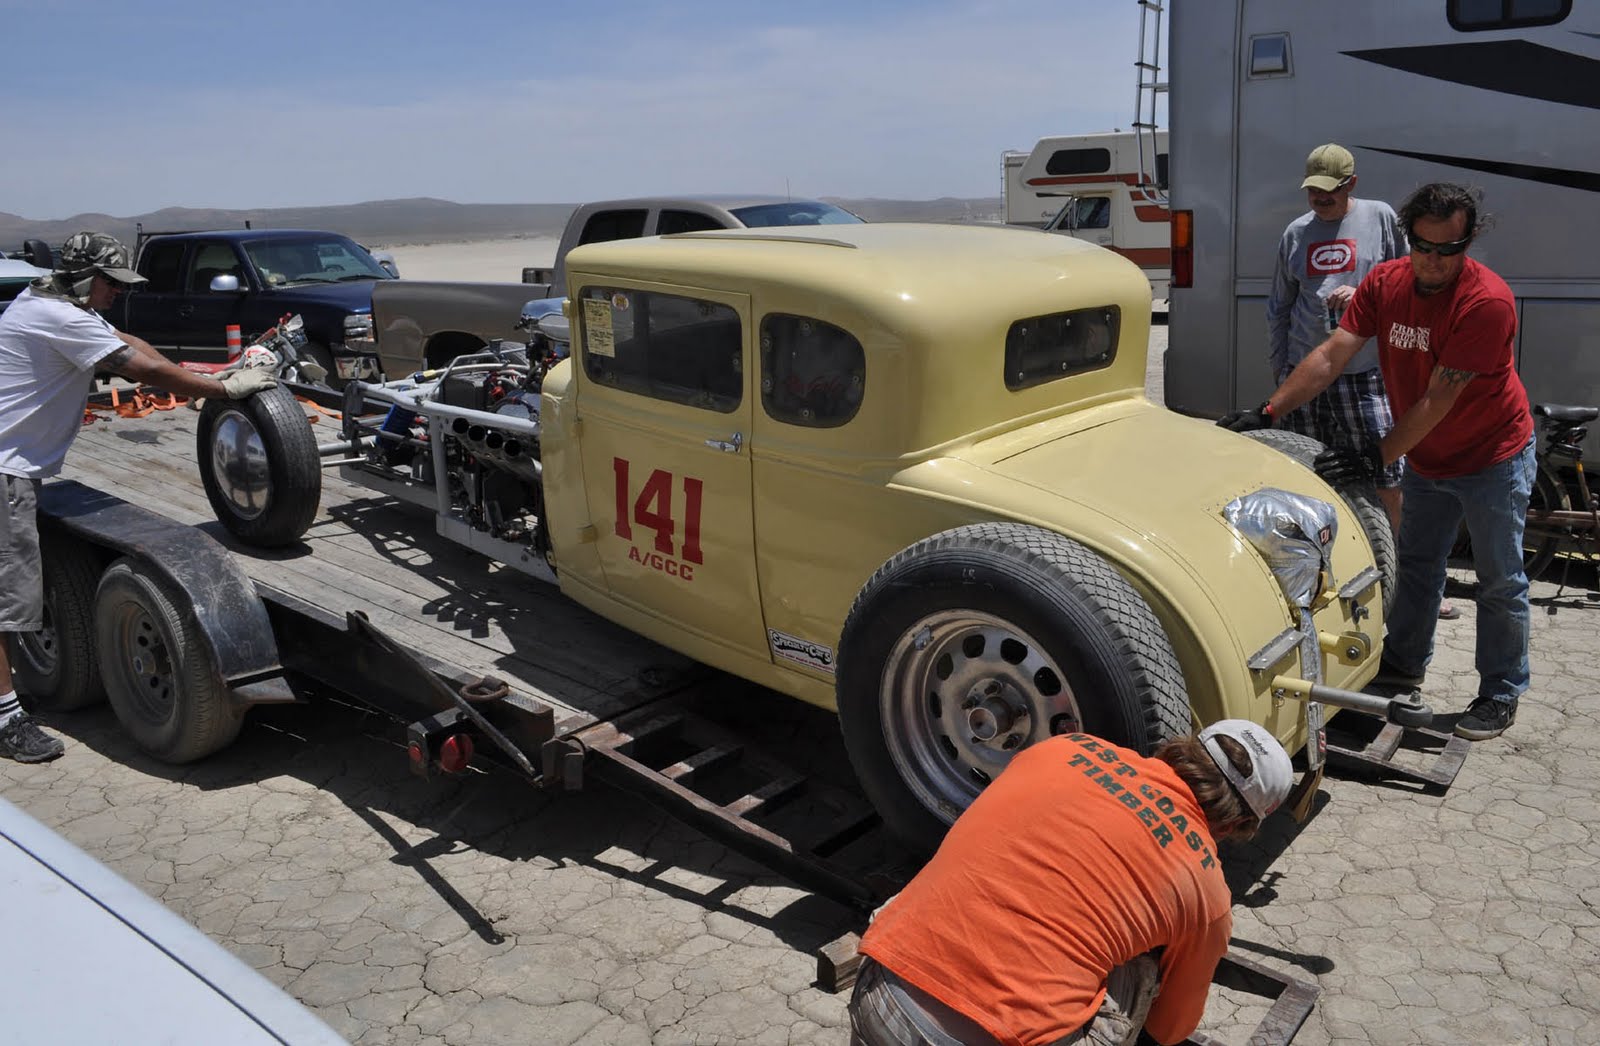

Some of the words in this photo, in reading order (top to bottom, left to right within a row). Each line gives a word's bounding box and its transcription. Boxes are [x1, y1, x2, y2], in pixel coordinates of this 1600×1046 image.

[613, 456, 703, 565] 141
[628, 546, 694, 581] A/GCC
[1064, 733, 1138, 777] WEST
[1139, 783, 1216, 870] COAST
[1067, 753, 1174, 849] TIMBER
